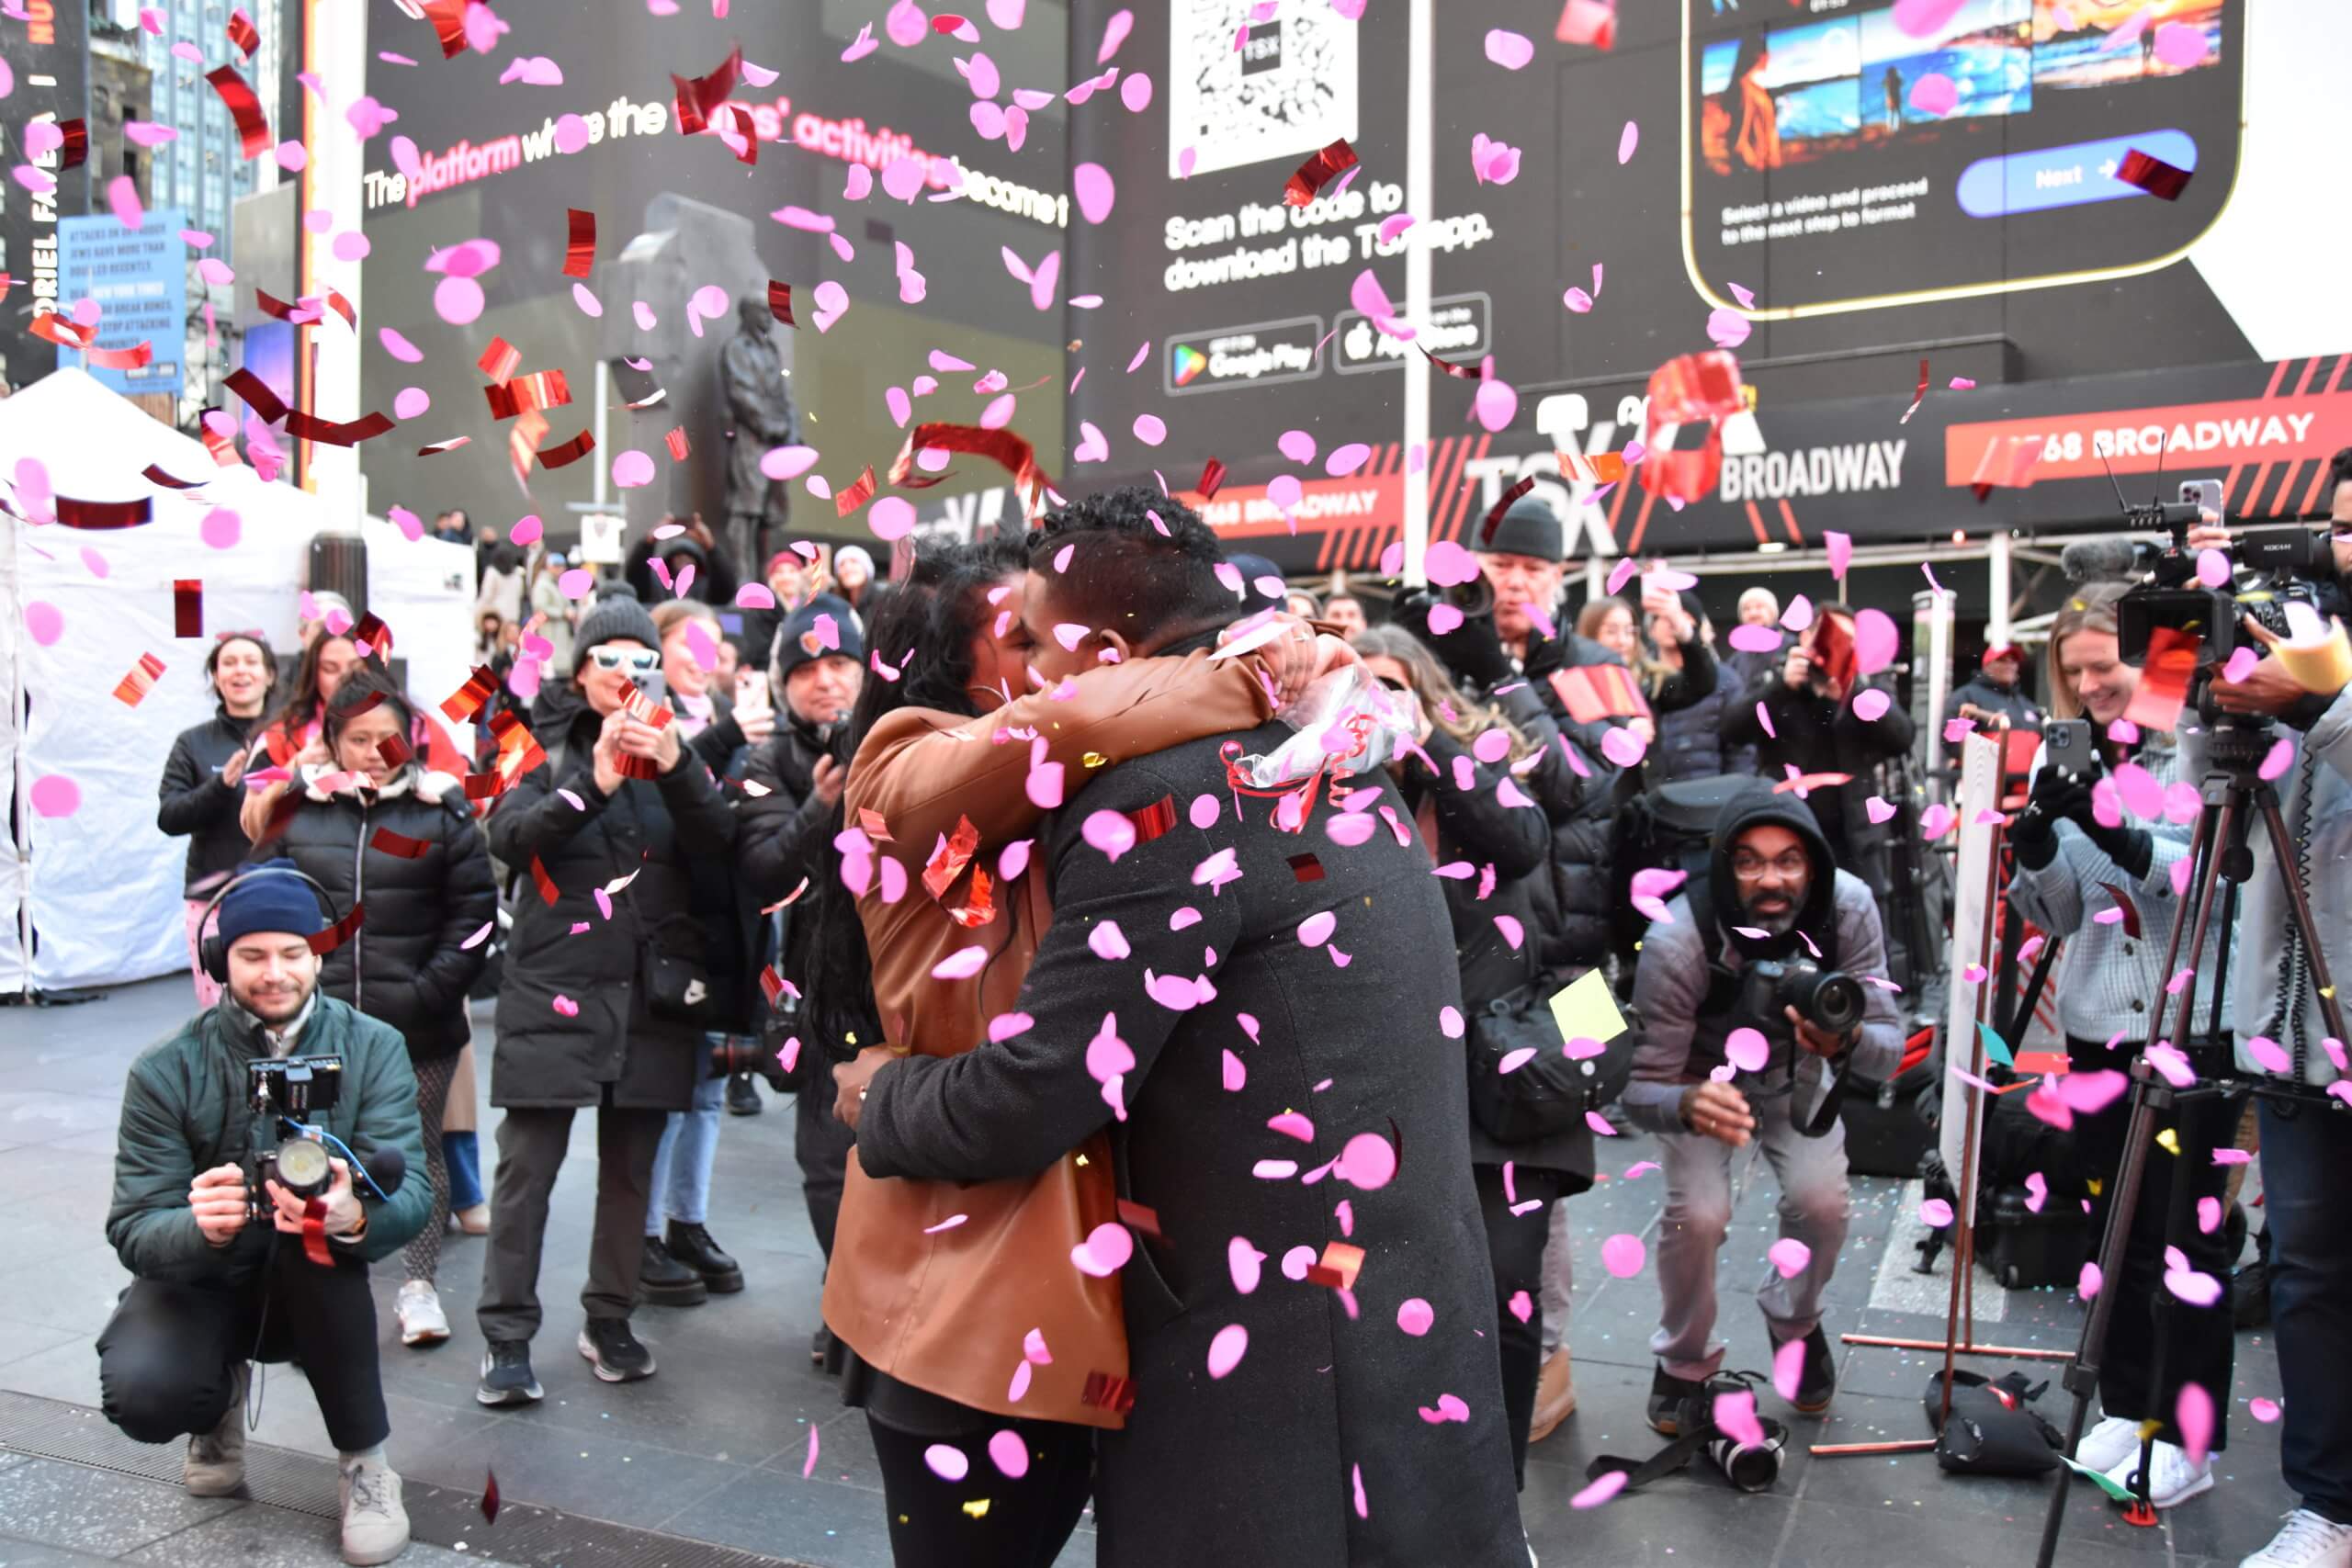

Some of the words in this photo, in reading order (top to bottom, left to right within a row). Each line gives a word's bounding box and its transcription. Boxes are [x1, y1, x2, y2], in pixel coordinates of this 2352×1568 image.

[364, 170, 406, 209] The
[405, 134, 521, 208] platform
[522, 117, 605, 163] whe
[607, 95, 668, 140] the
[2035, 164, 2083, 190] Next
[1165, 214, 1235, 250] Scan
[1239, 202, 1286, 236] the
[1289, 188, 1365, 229] code
[1369, 180, 1403, 214] to
[1721, 229, 1739, 245] to
[1740, 224, 1767, 243] the
[1769, 218, 1804, 239] next
[1804, 214, 1840, 233] step
[1841, 210, 1860, 228] to
[1861, 201, 1916, 224] format
[1722, 203, 1770, 226] Select
[1771, 202, 1783, 219] a
[1784, 194, 1828, 216] video
[1829, 186, 1860, 209] and
[1861, 176, 1928, 207] proceed
[1163, 238, 1296, 292] download
[1301, 233, 1351, 269] the
[1355, 221, 1410, 259] TS
[1428, 212, 1493, 253] app.
[1208, 347, 1272, 378] Google
[1272, 343, 1313, 372] Play
[2093, 412, 2314, 459] BROADWAY
[1720, 439, 1907, 503] BROADWAY
